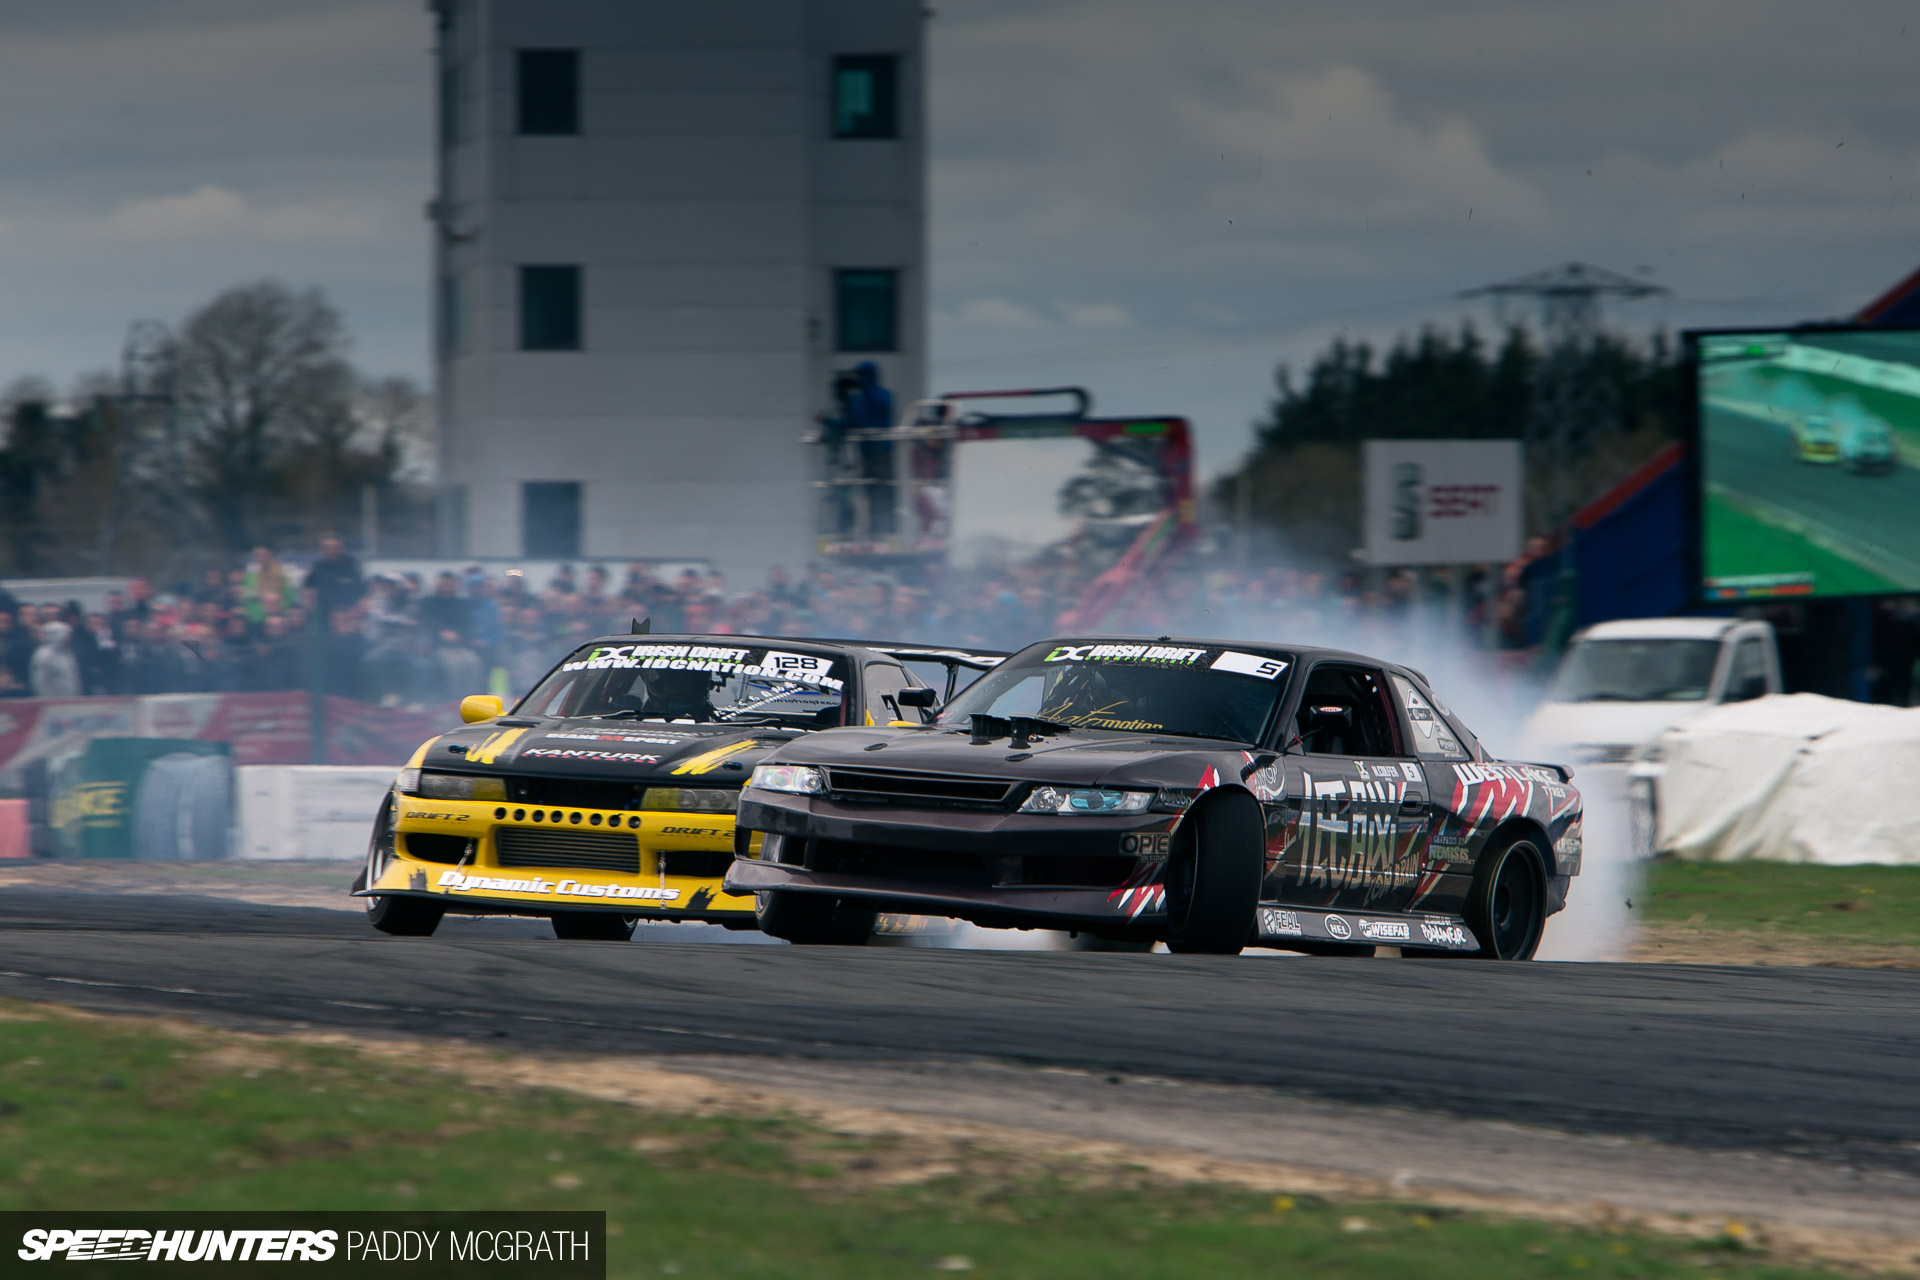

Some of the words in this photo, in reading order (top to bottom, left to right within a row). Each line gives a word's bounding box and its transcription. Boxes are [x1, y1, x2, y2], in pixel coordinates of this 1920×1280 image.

[631, 645, 690, 658] IRISH
[687, 645, 750, 661] DRIFT
[1089, 645, 1149, 659] IRISH
[1144, 645, 1207, 662] DRIFT
[773, 656, 819, 670] 128
[524, 748, 663, 762] KANTURK
[1406, 766, 1416, 778] 5
[404, 811, 455, 821] DRIFT
[455, 814, 471, 822] 2
[661, 826, 722, 836] DRIFT
[1121, 834, 1169, 853] OPIE
[437, 871, 555, 893] Dynamic
[555, 879, 681, 900] Customs
[1273, 910, 1301, 930] FEAL
[1330, 923, 1349, 936] HEL
[1372, 924, 1410, 937] WISEFAB
